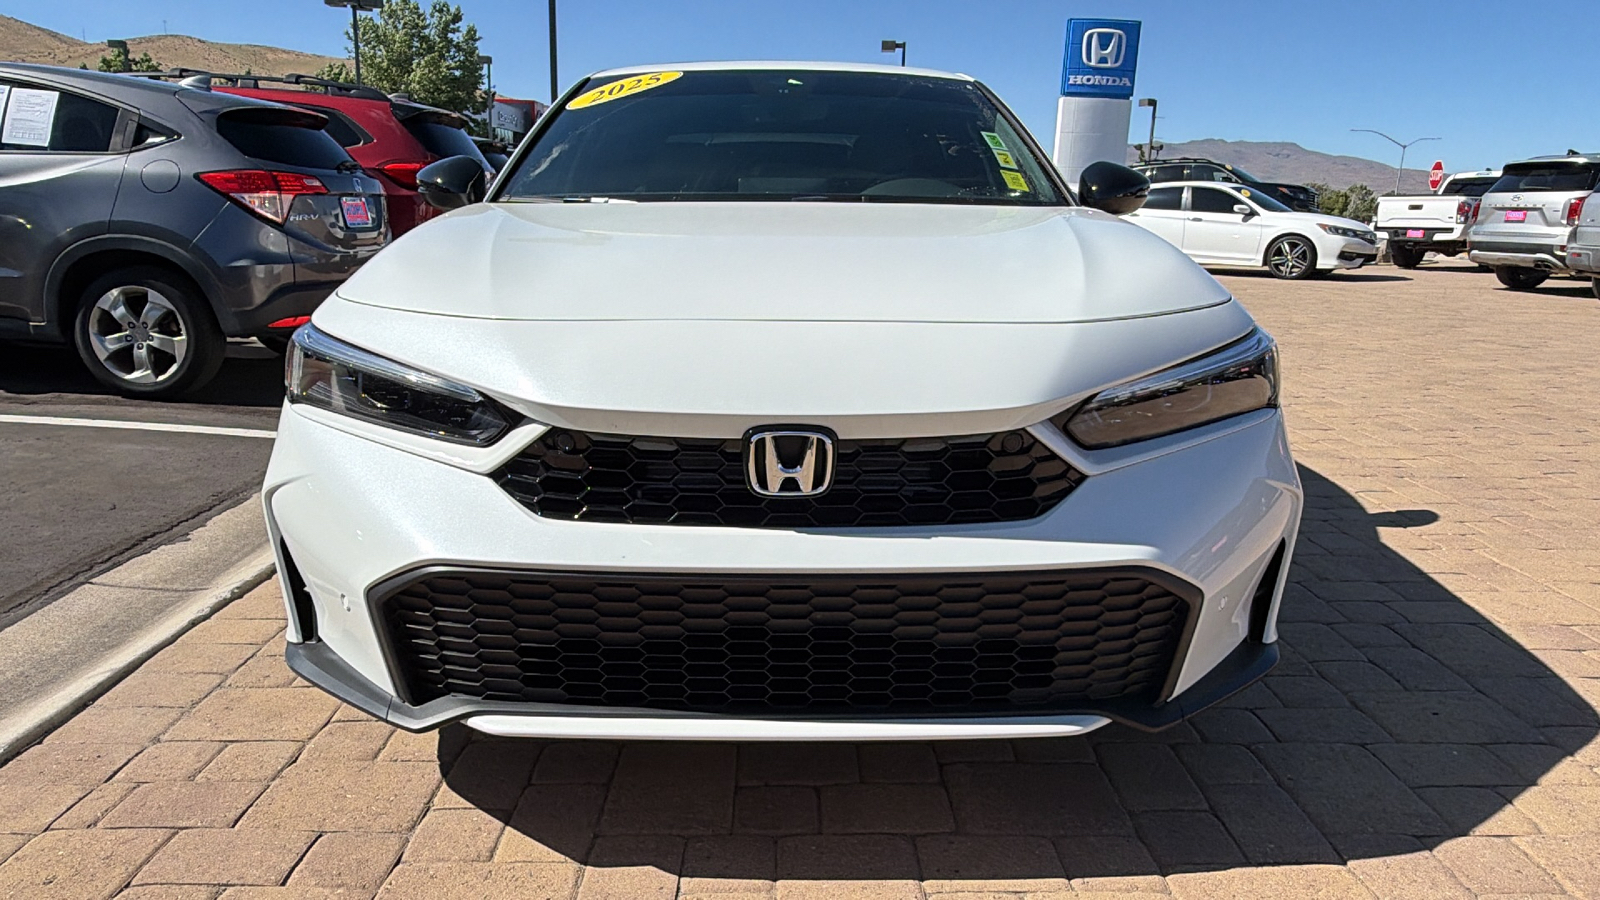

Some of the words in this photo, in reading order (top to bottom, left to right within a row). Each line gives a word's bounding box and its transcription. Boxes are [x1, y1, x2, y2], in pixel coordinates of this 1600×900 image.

[1068, 75, 1132, 86] HONDA
[590, 74, 662, 103] 2025
[1430, 169, 1443, 180] STOP
